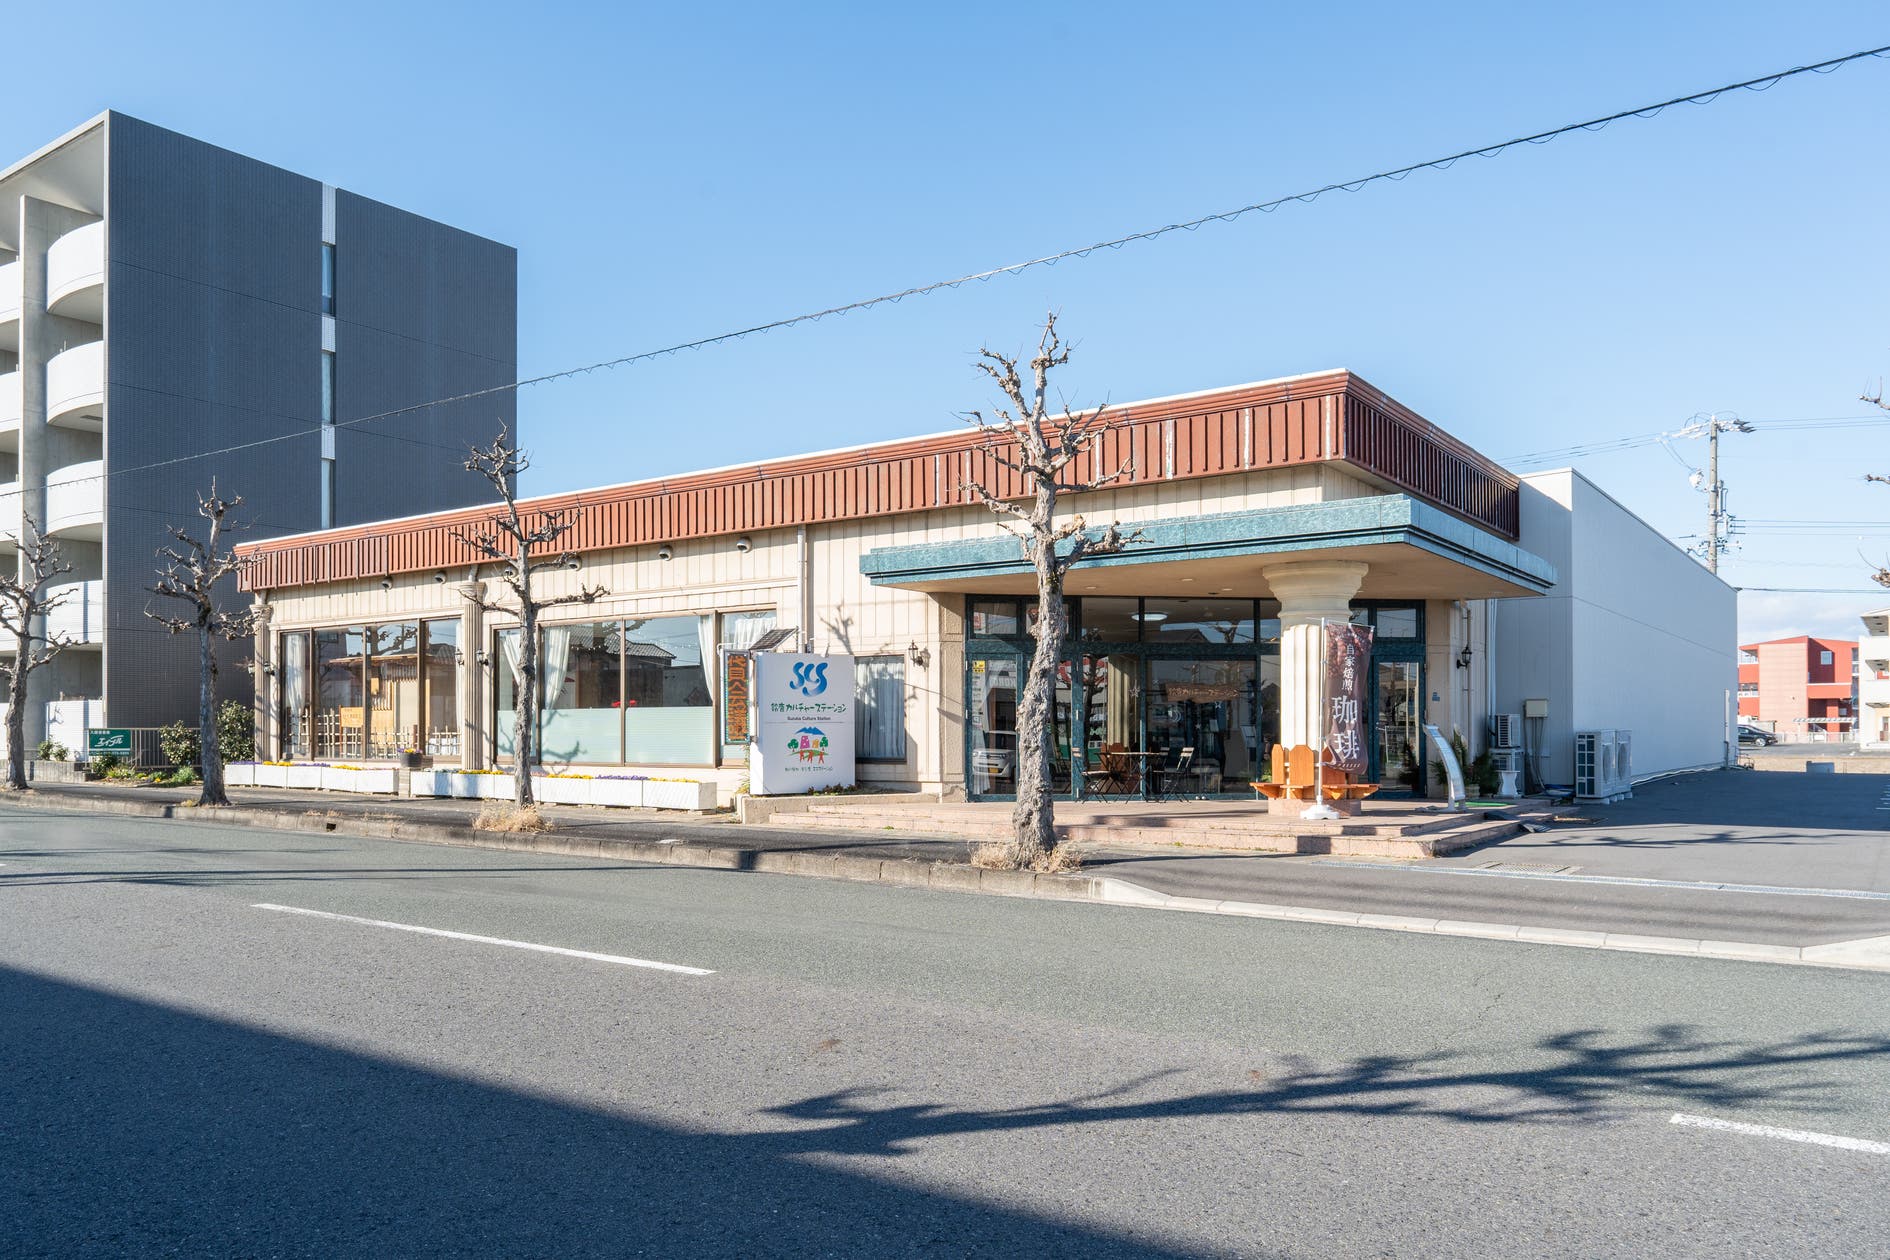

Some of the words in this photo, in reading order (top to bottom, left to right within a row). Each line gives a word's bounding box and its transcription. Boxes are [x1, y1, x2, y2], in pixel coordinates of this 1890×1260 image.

[789, 661, 828, 697] SCS
[94, 734, 124, 747] エイブル
[1331, 695, 1360, 759] 珈琲
